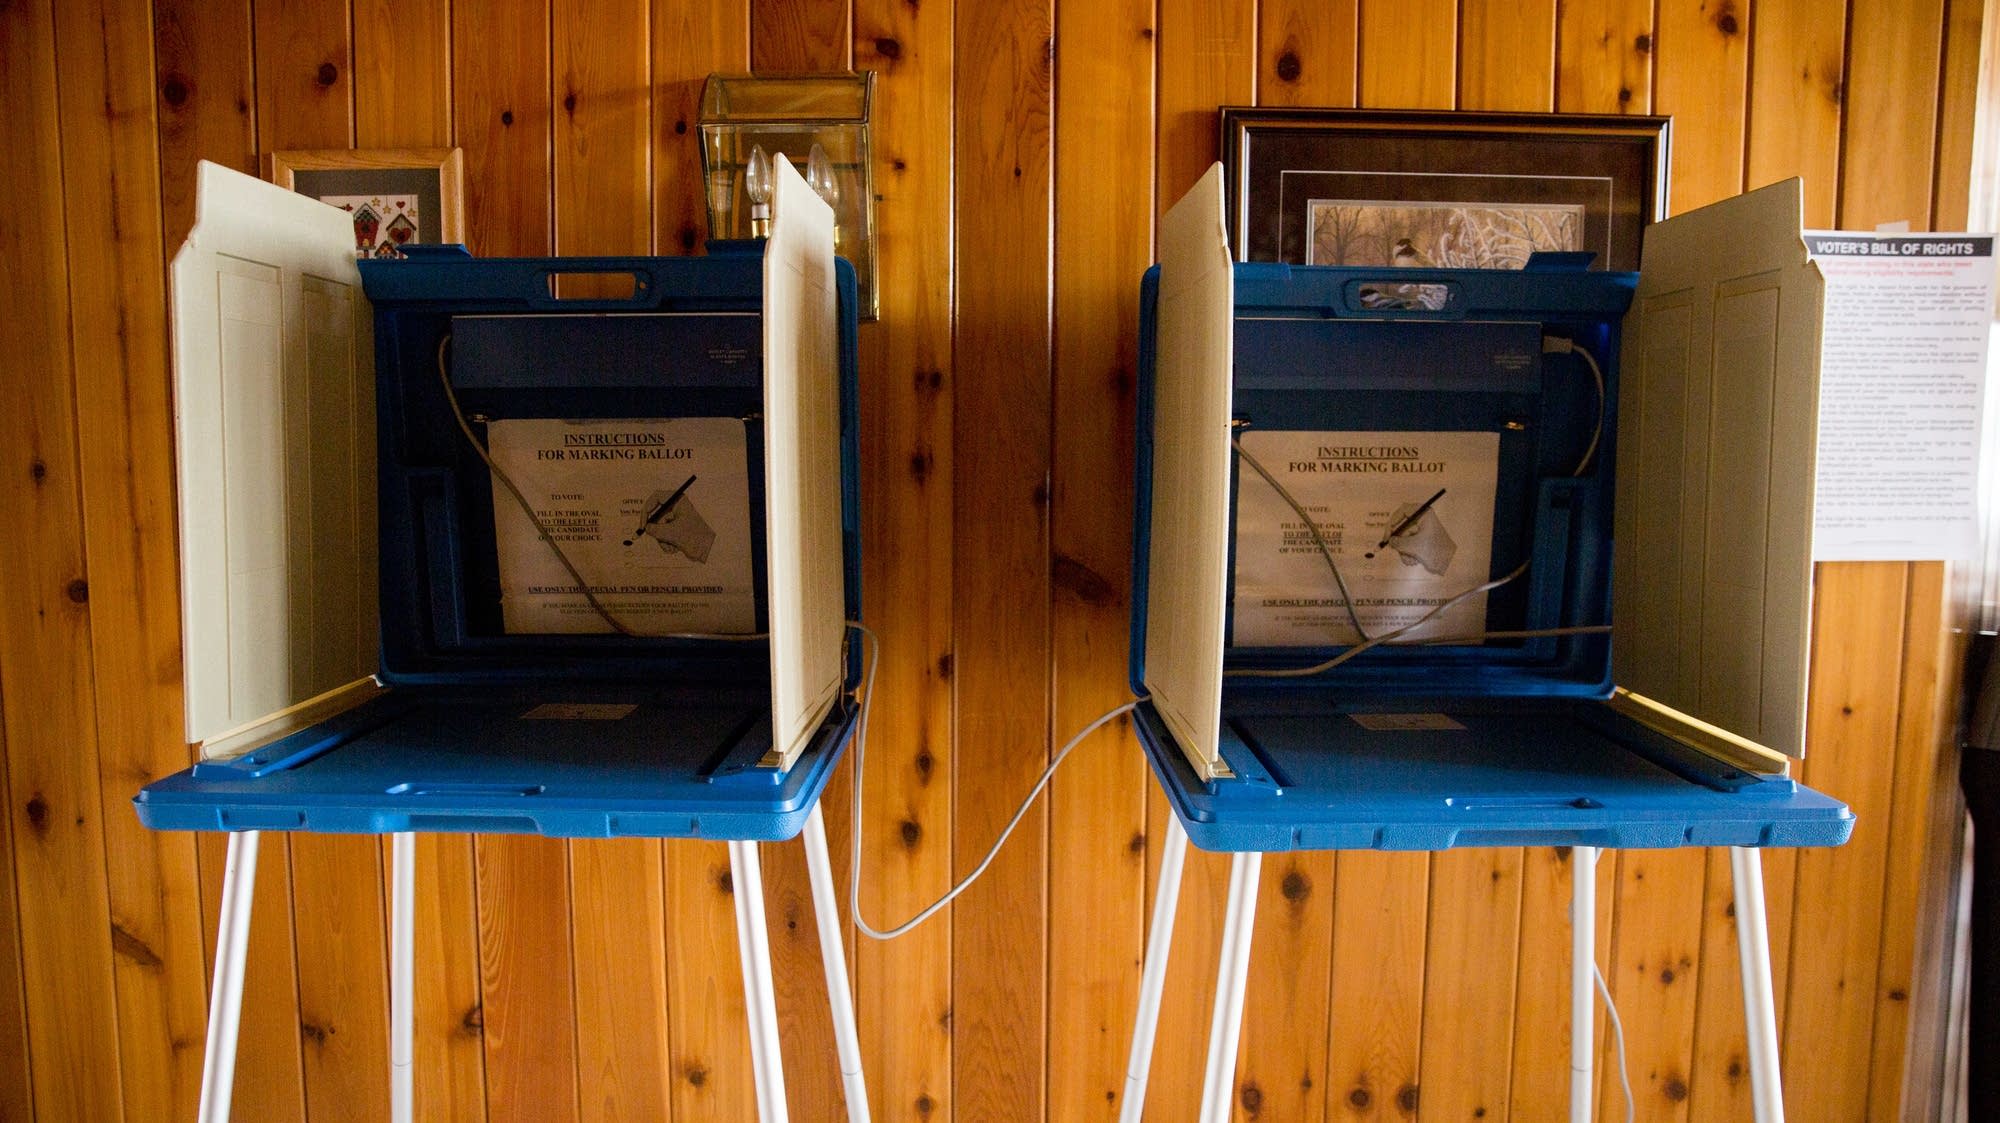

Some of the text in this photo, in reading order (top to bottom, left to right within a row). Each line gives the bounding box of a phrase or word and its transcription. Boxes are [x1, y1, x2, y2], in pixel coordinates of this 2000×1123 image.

[1816, 241, 1974, 255] VOTER'S BILL OF RIGHTS
[564, 433, 665, 446] INSTRUCTIONS
[538, 448, 694, 460] FOR MARKING BALLOT
[1317, 446, 1419, 459] INSTRUCTIONS
[1289, 462, 1447, 473] FOR MARKING BALLOT
